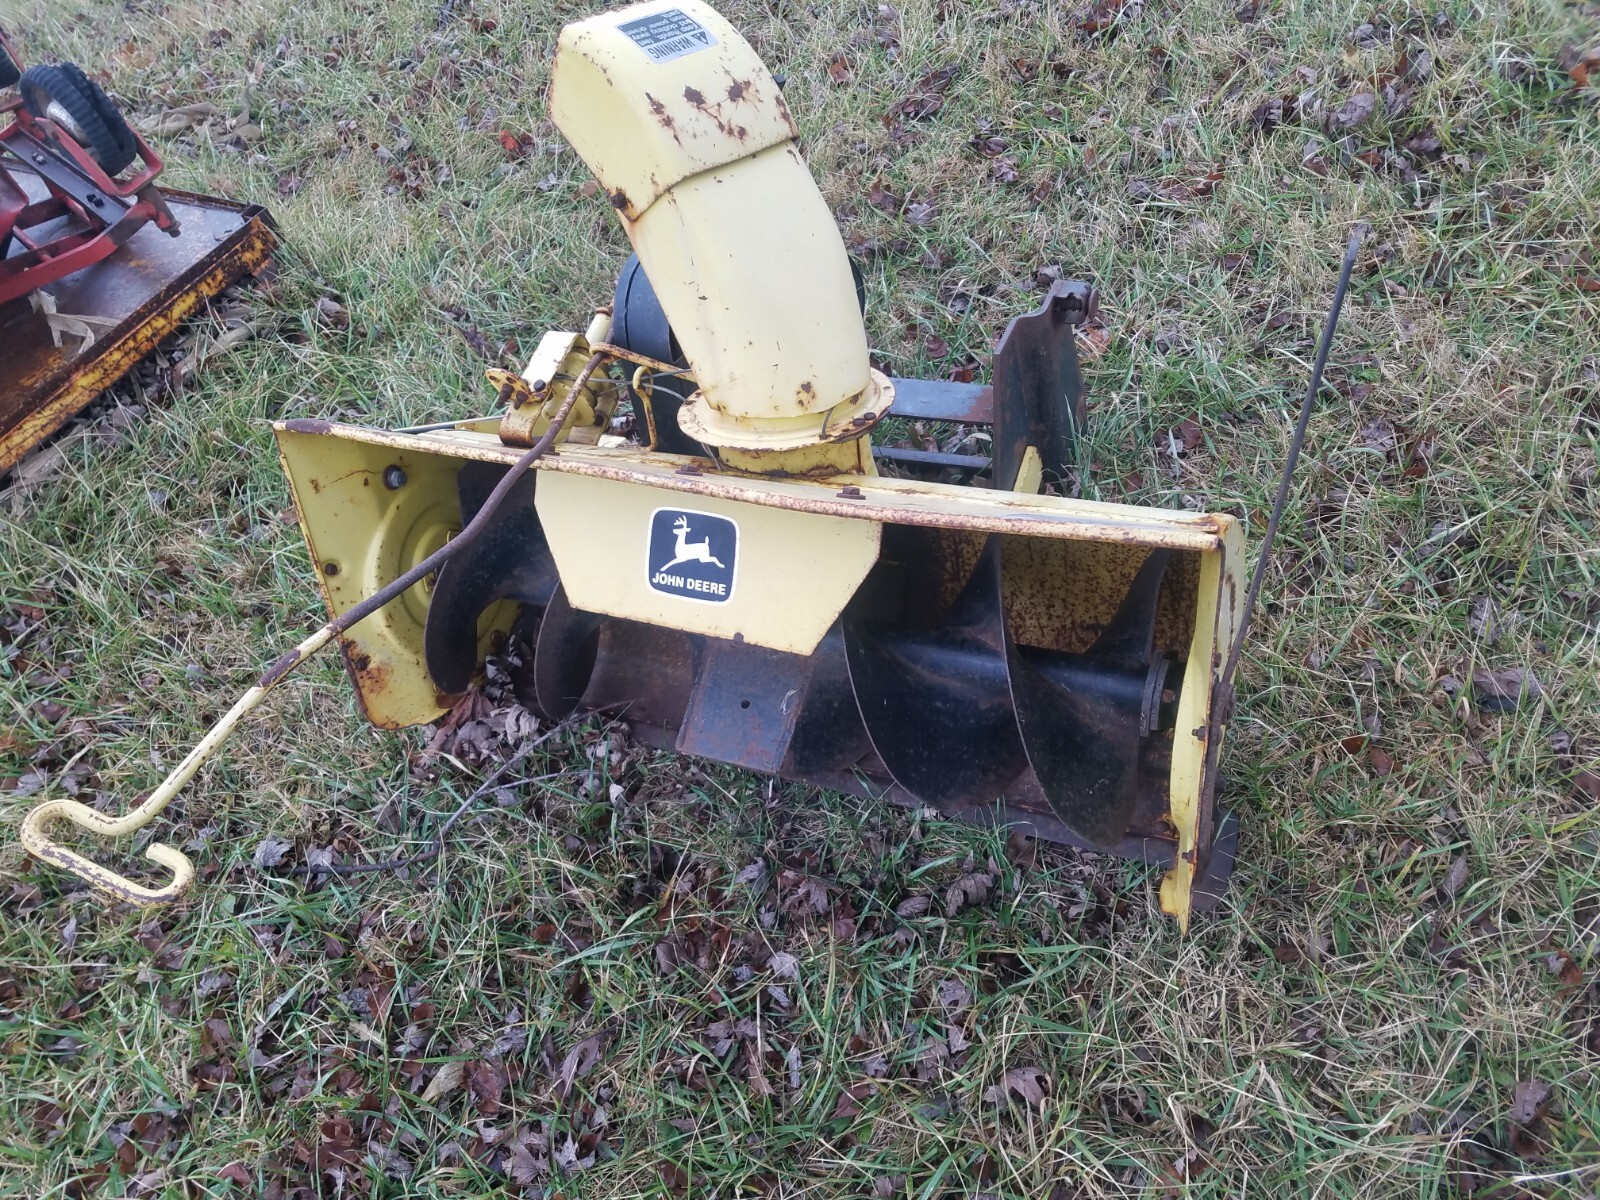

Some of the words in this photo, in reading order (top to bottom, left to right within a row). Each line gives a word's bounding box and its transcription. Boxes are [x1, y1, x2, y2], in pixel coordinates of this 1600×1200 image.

[670, 14, 687, 22] from
[649, 19, 668, 29] power
[679, 19, 694, 27] and
[625, 26, 647, 36] driven
[649, 23, 678, 34] clothing
[680, 24, 698, 32] Keep
[631, 31, 650, 40] away
[637, 38, 655, 47] feet
[647, 37, 695, 58] WARNING
[652, 572, 684, 587] JOHN
[687, 578, 726, 595] DEERE
